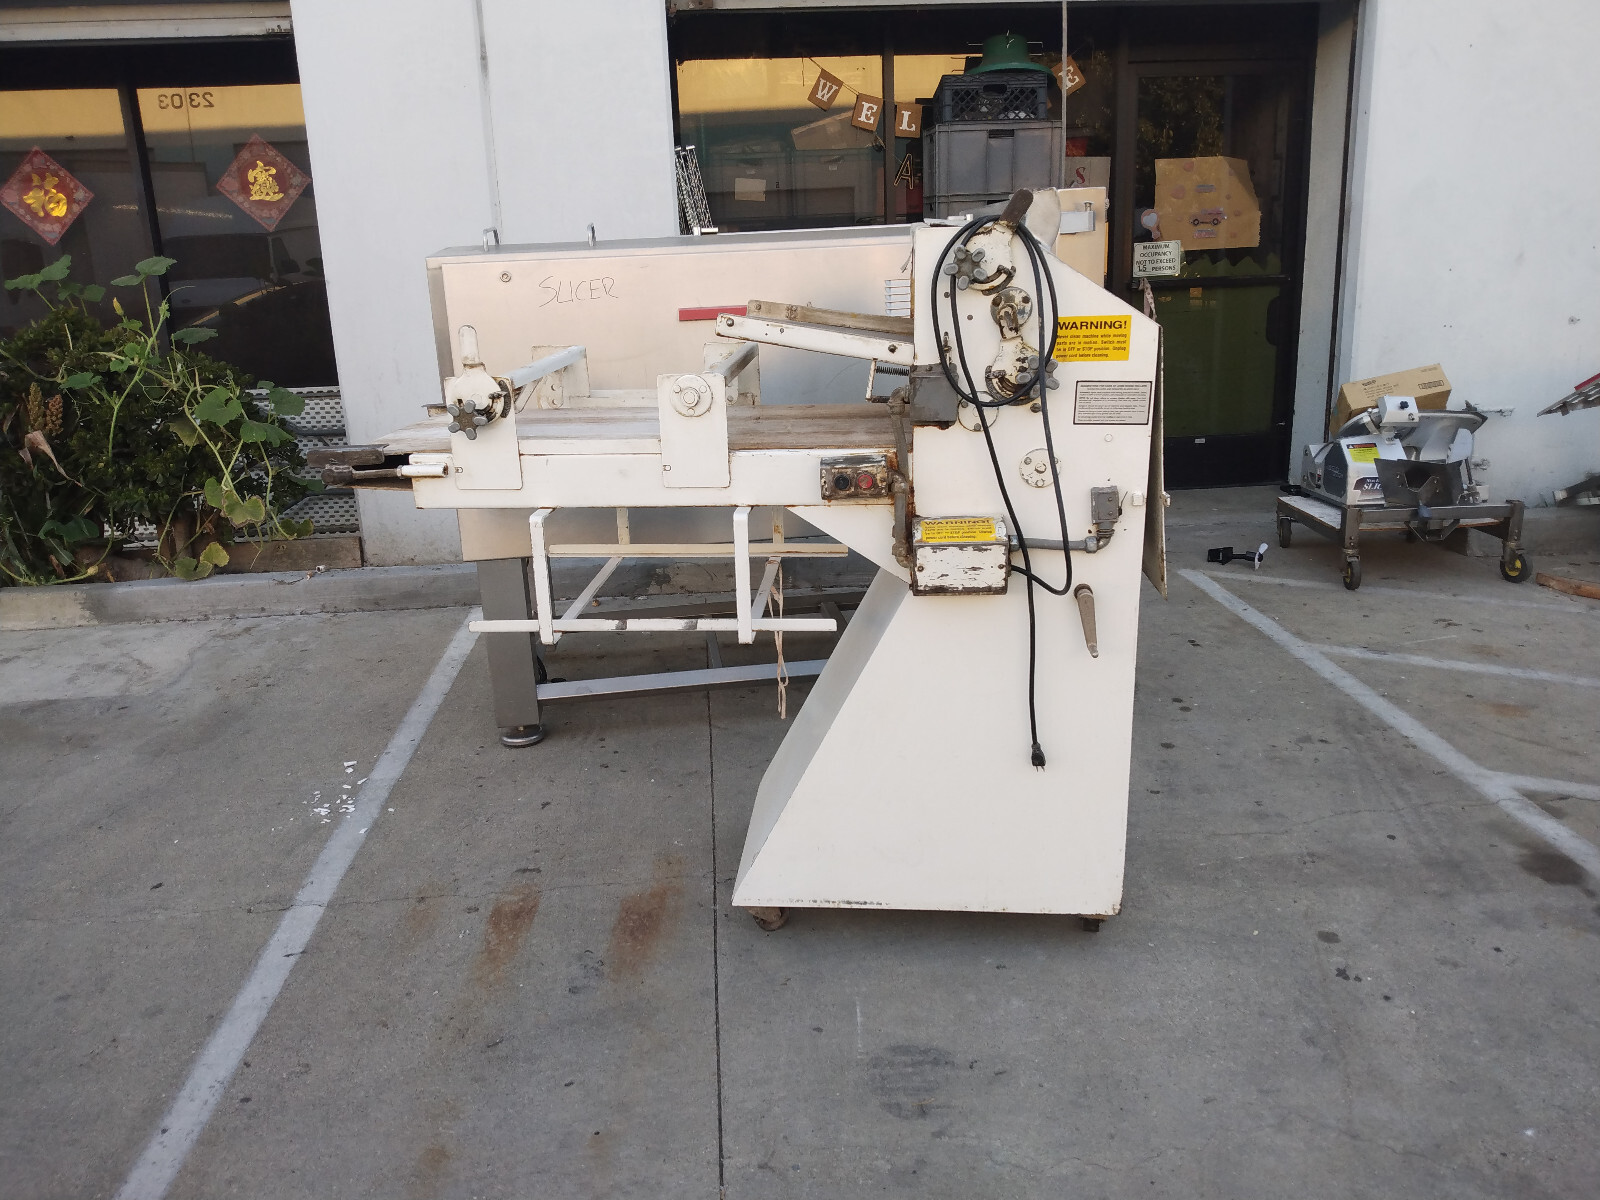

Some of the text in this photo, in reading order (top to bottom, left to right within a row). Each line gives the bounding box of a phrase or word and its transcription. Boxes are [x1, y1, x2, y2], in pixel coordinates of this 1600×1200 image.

[22, 172, 68, 218] 福
[538, 275, 619, 308] SLICER
[1057, 320, 1128, 330] WARNING!
